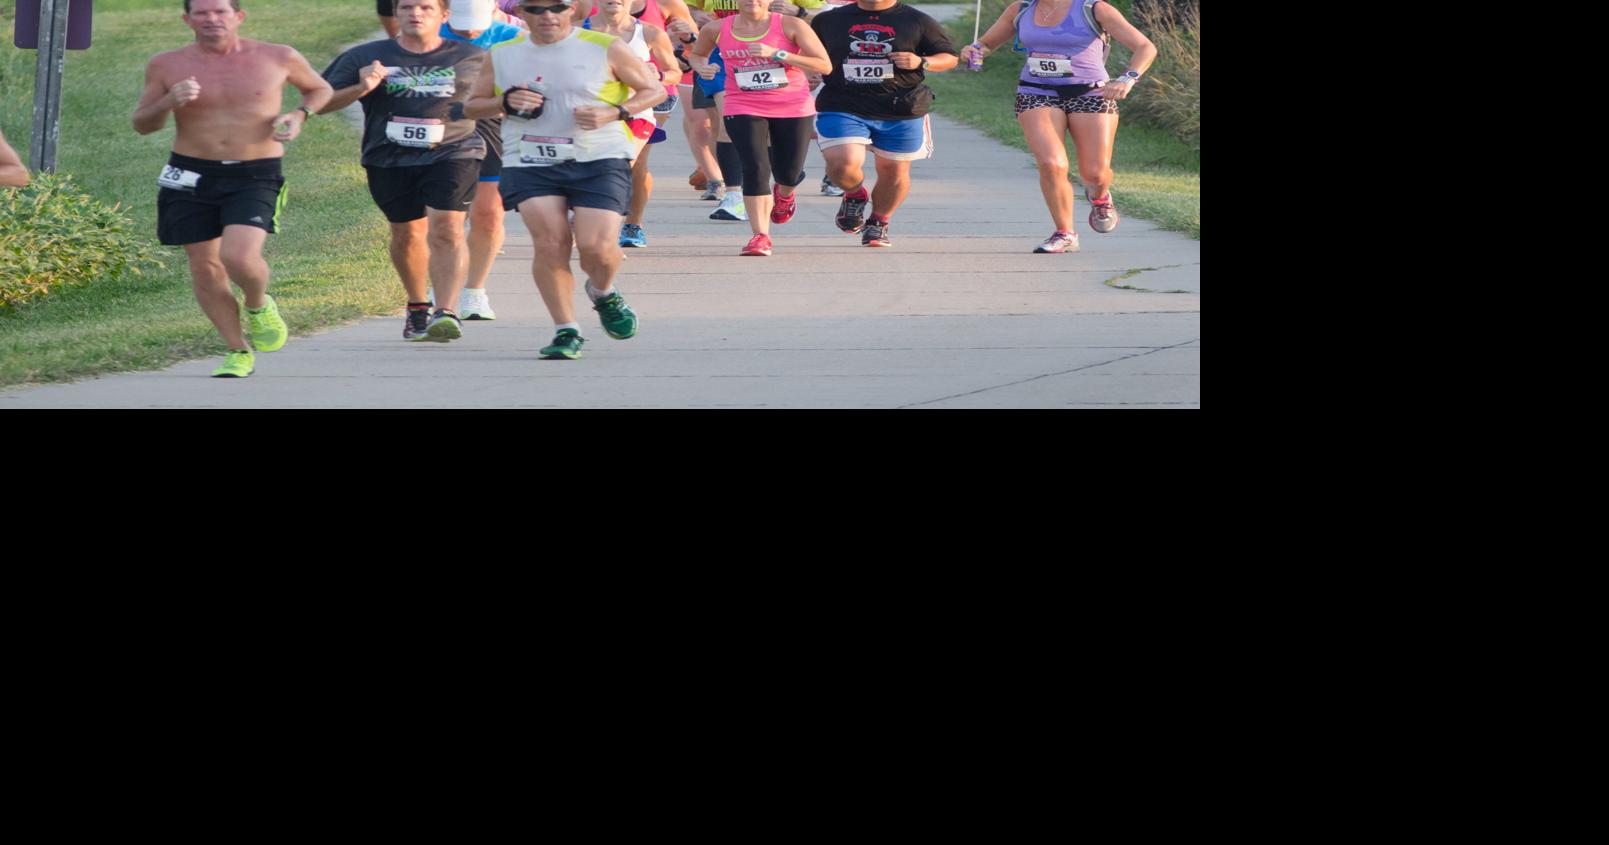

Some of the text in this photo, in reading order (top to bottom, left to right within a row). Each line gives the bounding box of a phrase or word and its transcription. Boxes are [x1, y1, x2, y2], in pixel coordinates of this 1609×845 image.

[854, 66, 883, 77] 120
[1039, 60, 1057, 72] 59
[752, 72, 772, 84] 42
[403, 126, 427, 140] 56
[536, 145, 557, 158] 15
[164, 168, 183, 181] 26
